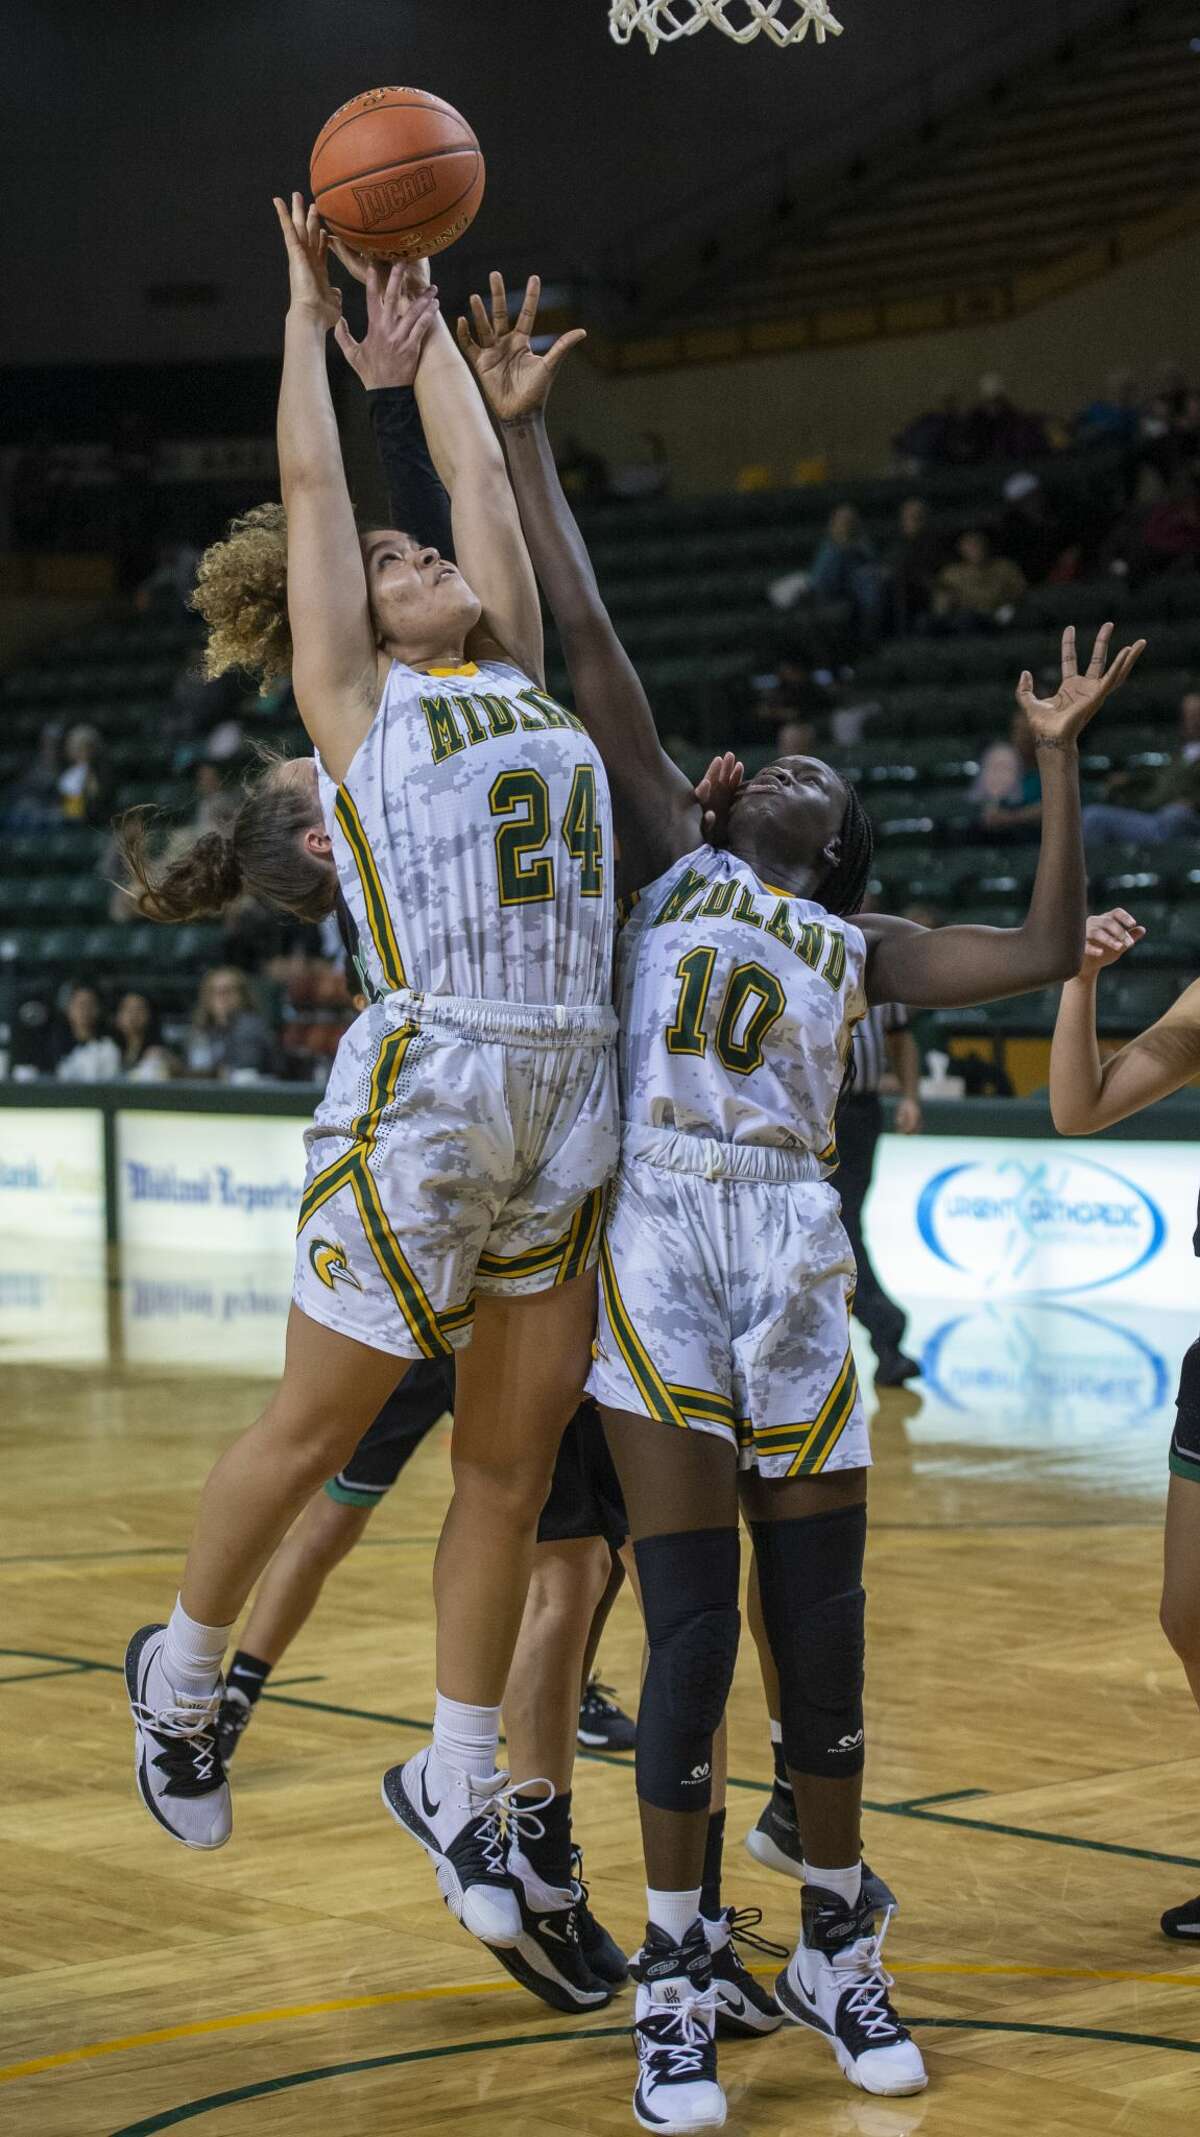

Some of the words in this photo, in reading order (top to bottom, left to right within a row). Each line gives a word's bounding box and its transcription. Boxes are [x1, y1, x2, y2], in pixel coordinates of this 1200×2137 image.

[419, 687, 586, 765] MIDLA
[488, 764, 603, 907] 24
[666, 945, 787, 1076] 10
